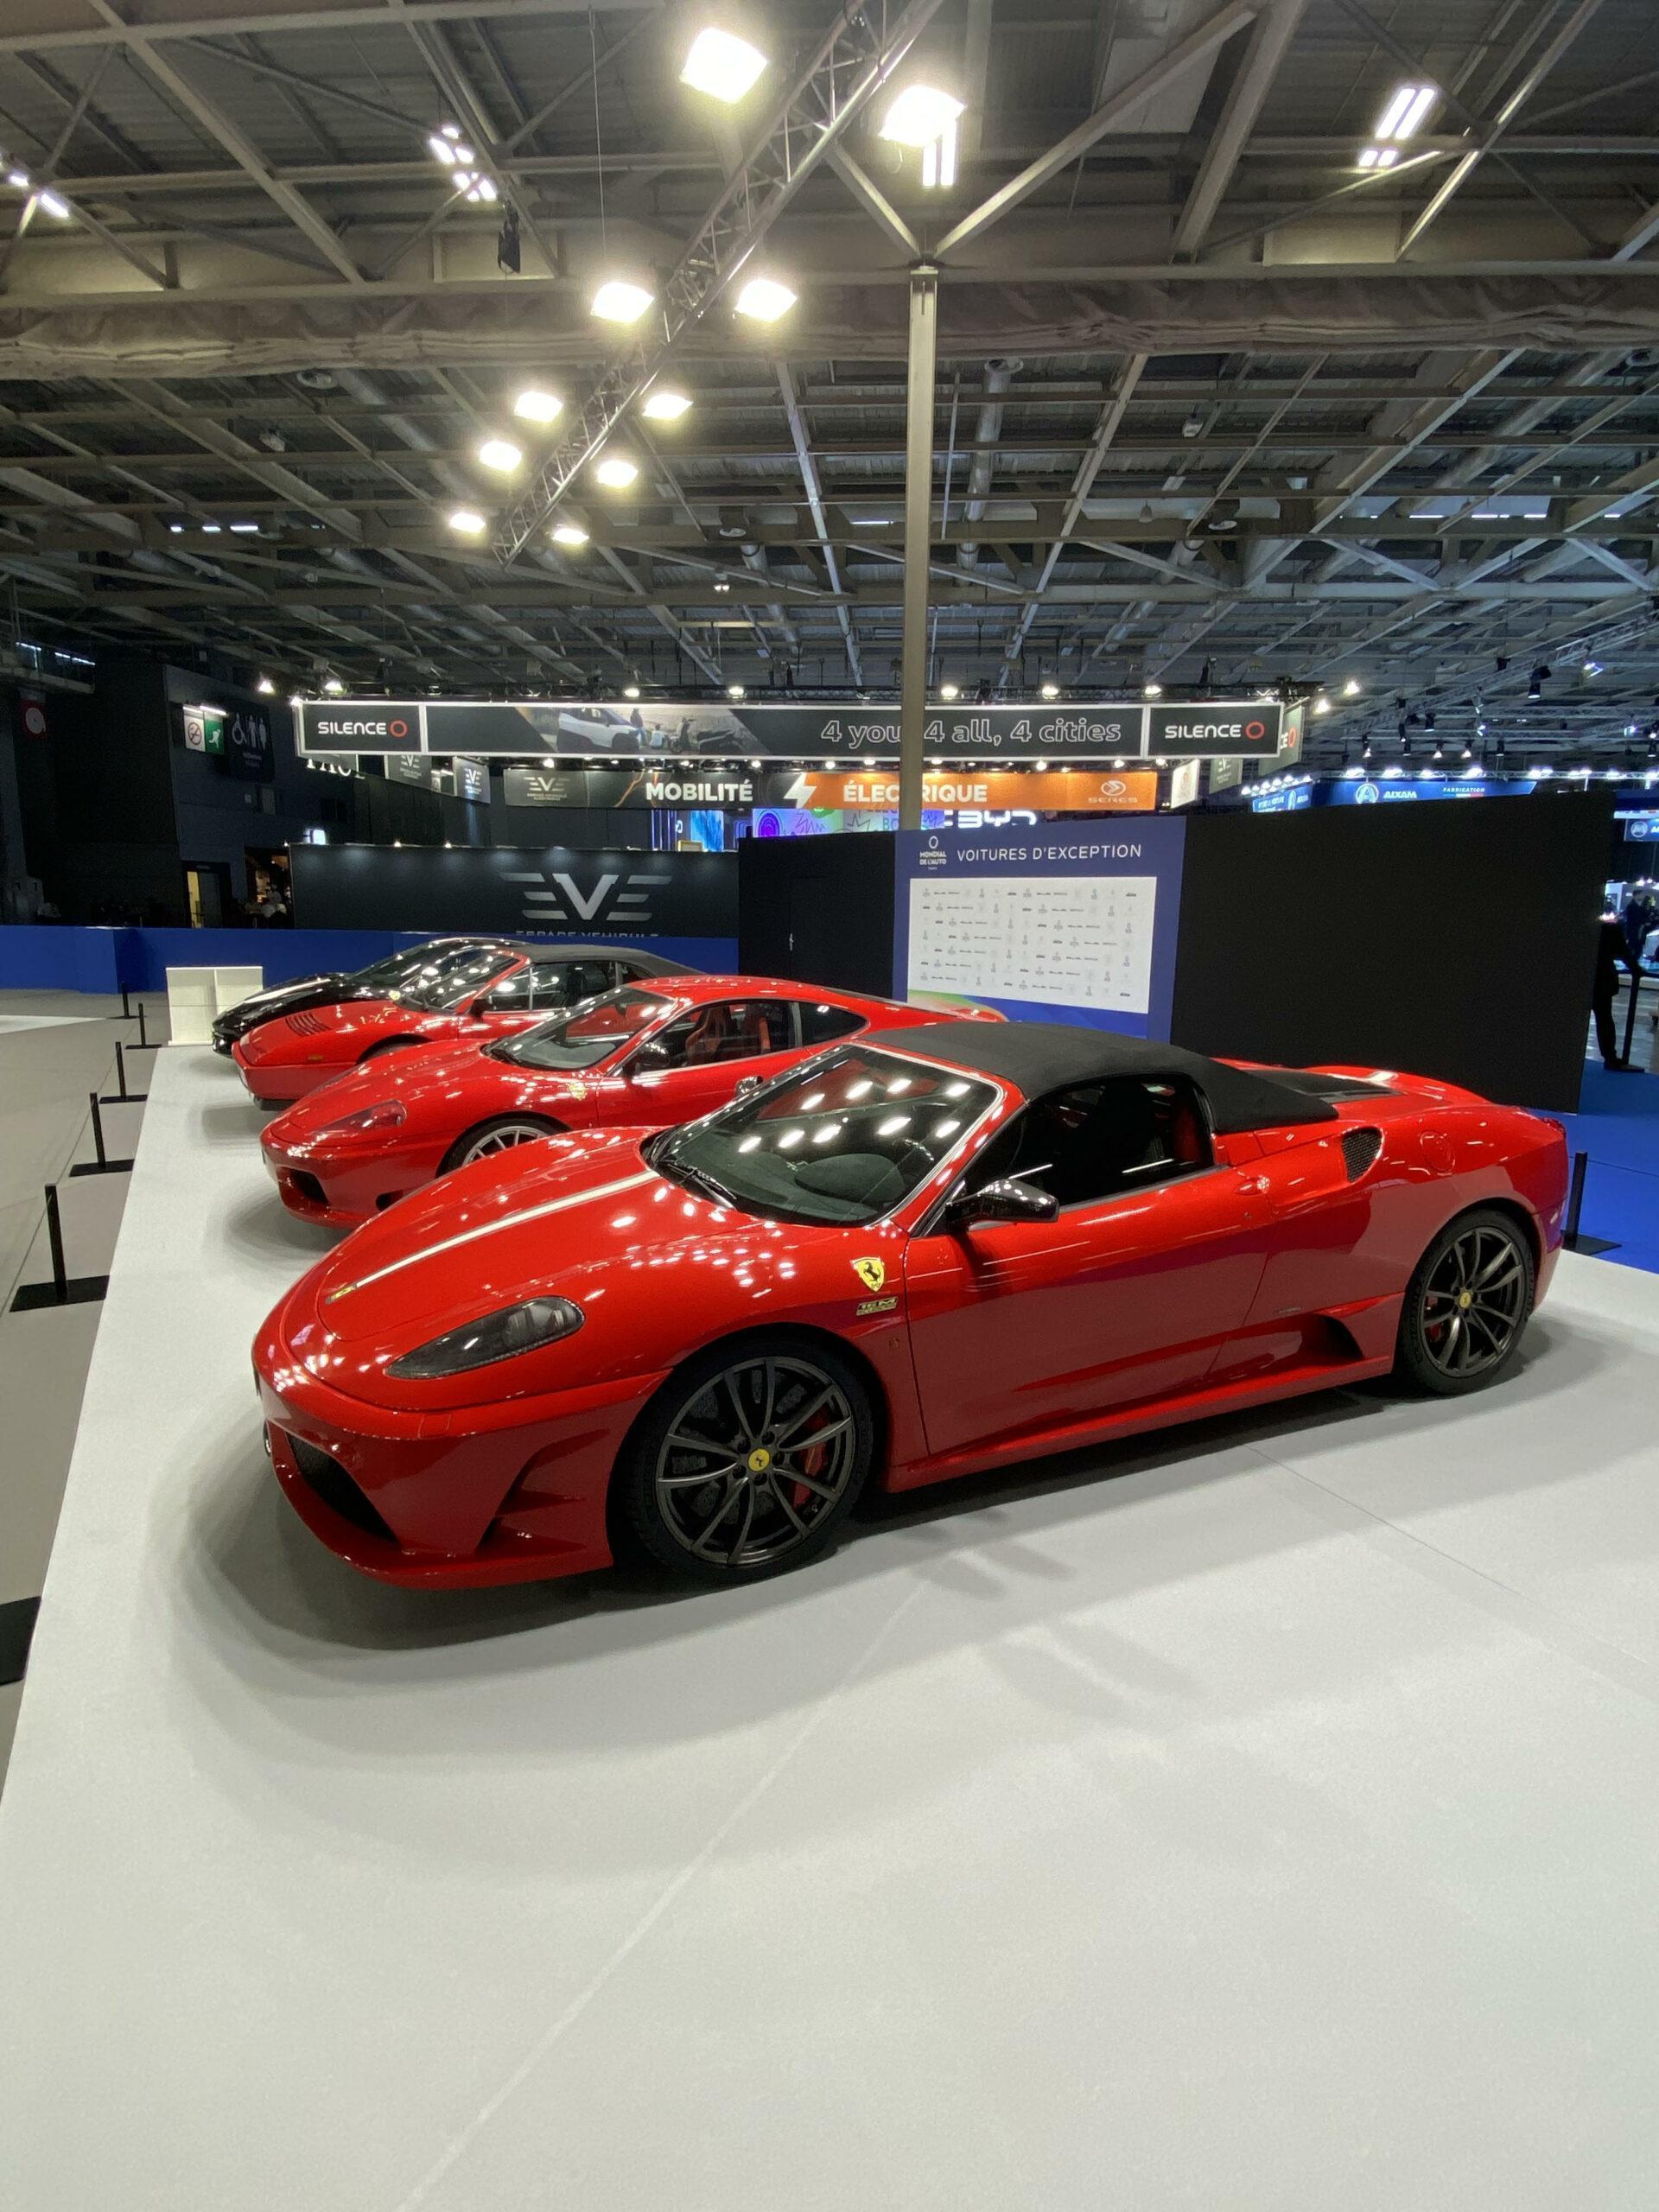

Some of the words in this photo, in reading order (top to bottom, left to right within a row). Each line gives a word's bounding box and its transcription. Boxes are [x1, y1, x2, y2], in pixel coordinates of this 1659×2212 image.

[317, 721, 387, 735] SILENCE
[820, 720, 842, 742] 4
[924, 720, 945, 742] 4
[951, 719, 1002, 747] all,
[1010, 720, 1033, 742] 4
[1039, 718, 1122, 743] cities
[1164, 724, 1242, 740] SILENCE
[646, 779, 753, 802] MOBILITÉ
[842, 779, 988, 804] ÉLECRIQUE
[957, 847, 1027, 861] VOITURES
[1033, 844, 1142, 860] D'EXCEPTION
